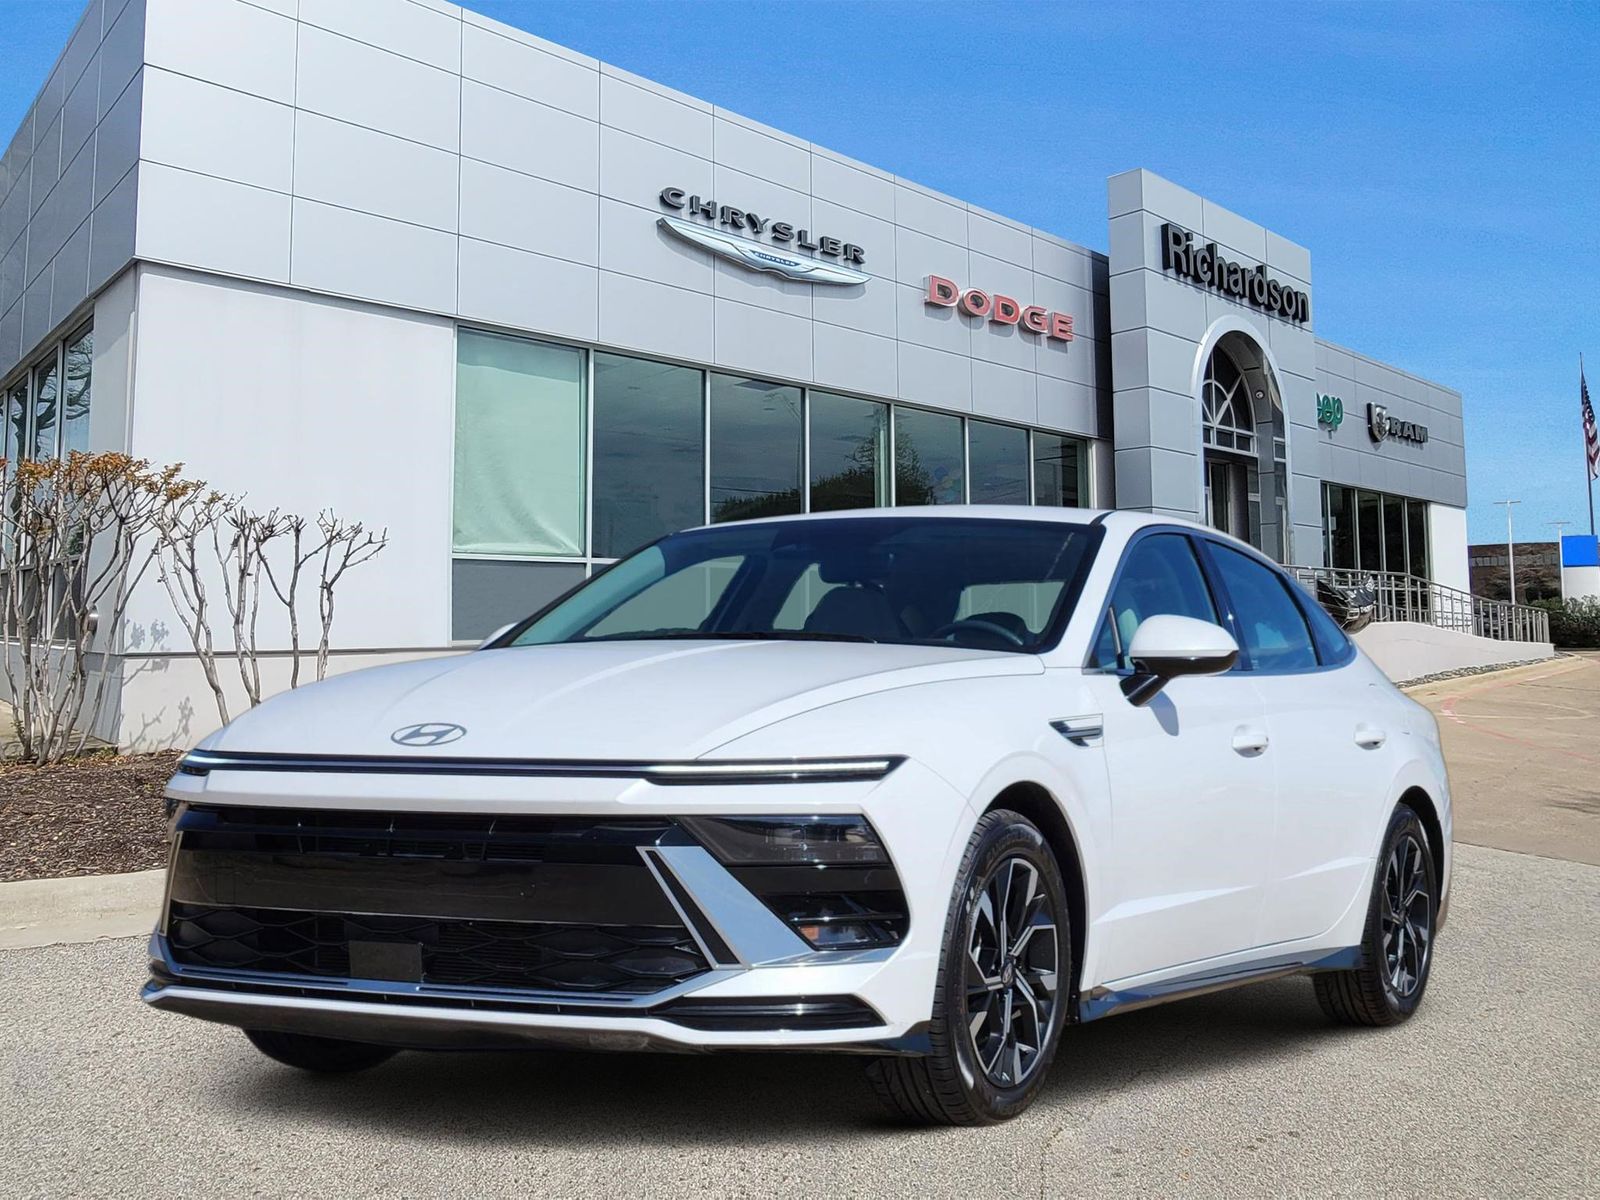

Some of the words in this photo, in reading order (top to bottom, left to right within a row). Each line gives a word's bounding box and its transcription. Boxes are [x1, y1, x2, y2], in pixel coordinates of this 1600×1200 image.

[659, 187, 866, 264] CHRYSLER
[923, 274, 1073, 342] DODGE
[1161, 223, 1309, 323] Richardson
[1387, 416, 1429, 443] RAM
